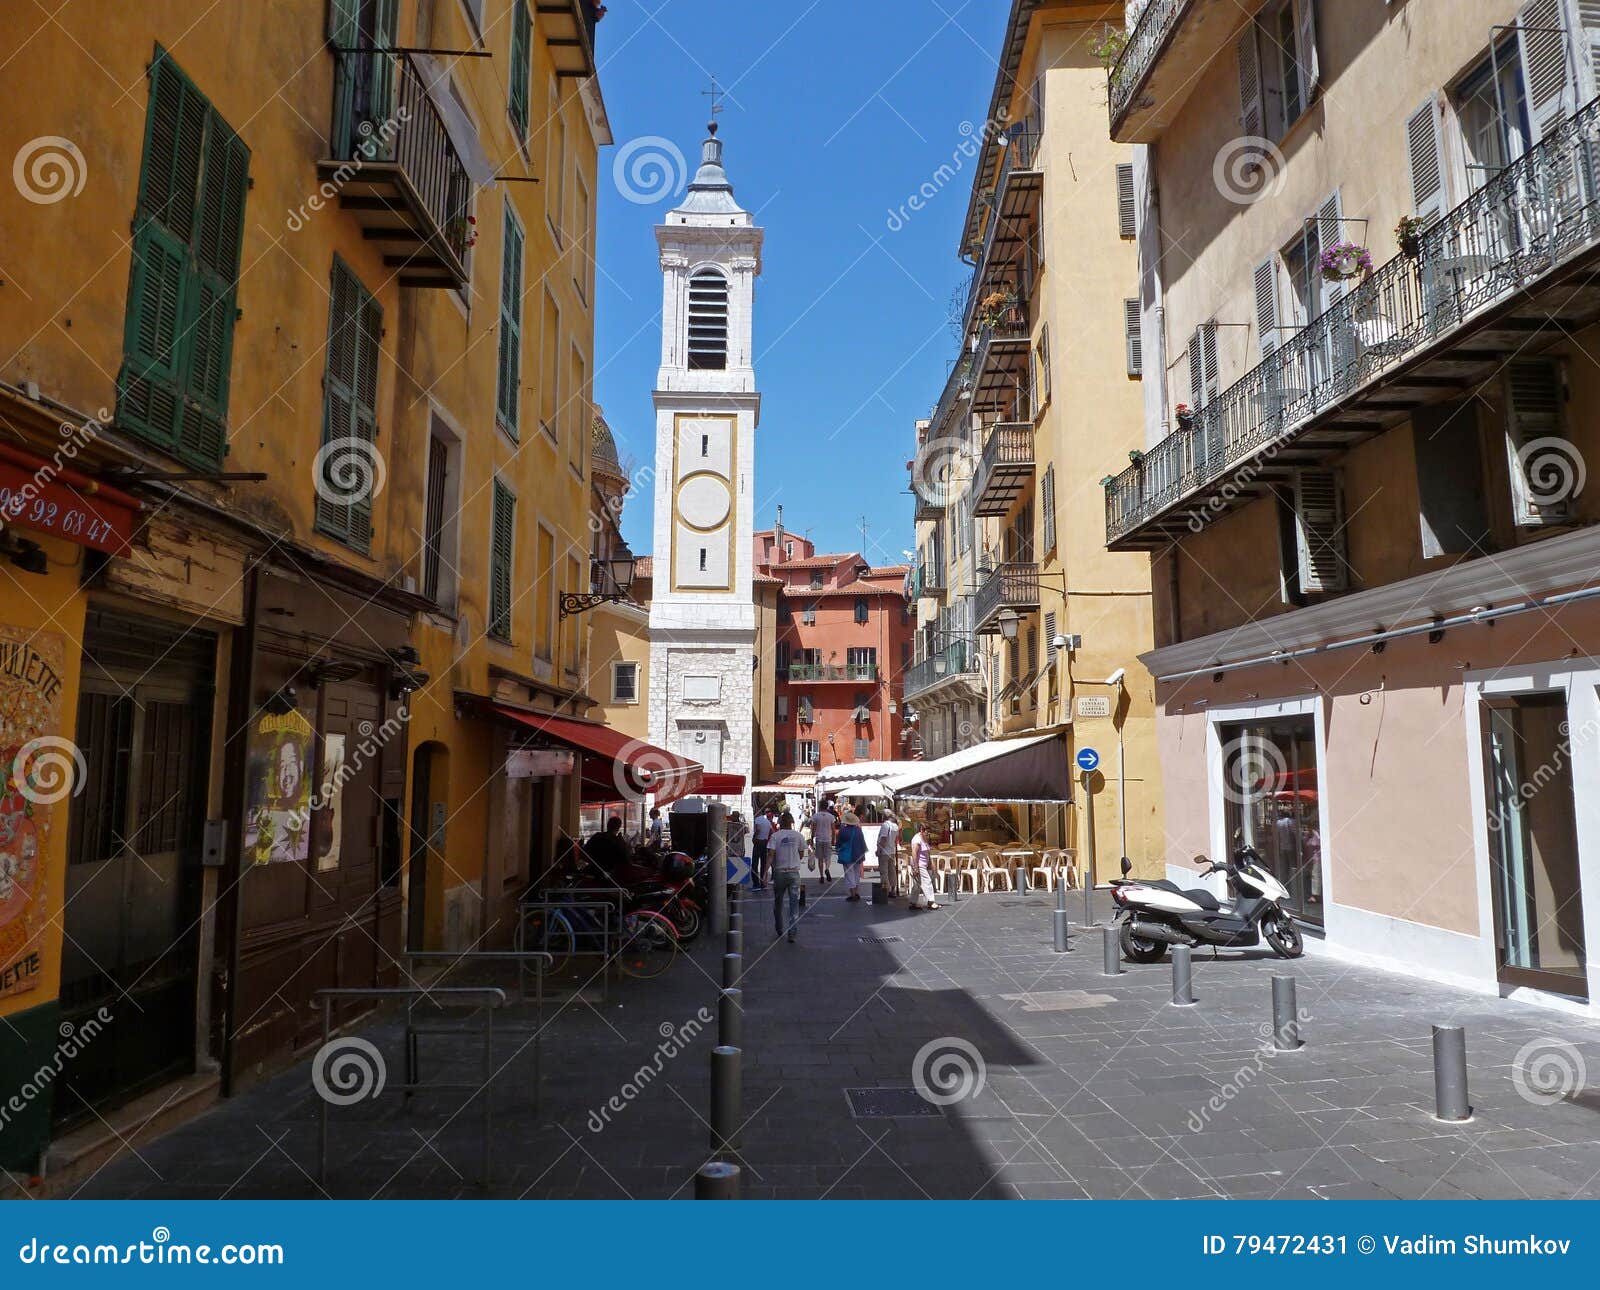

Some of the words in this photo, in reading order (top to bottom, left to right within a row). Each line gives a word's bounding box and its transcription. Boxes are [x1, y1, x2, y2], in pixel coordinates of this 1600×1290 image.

[29, 499, 58, 526] 92
[62, 510, 86, 535] 68
[87, 519, 112, 543] 47
[0, 642, 62, 704] ULIETTE
